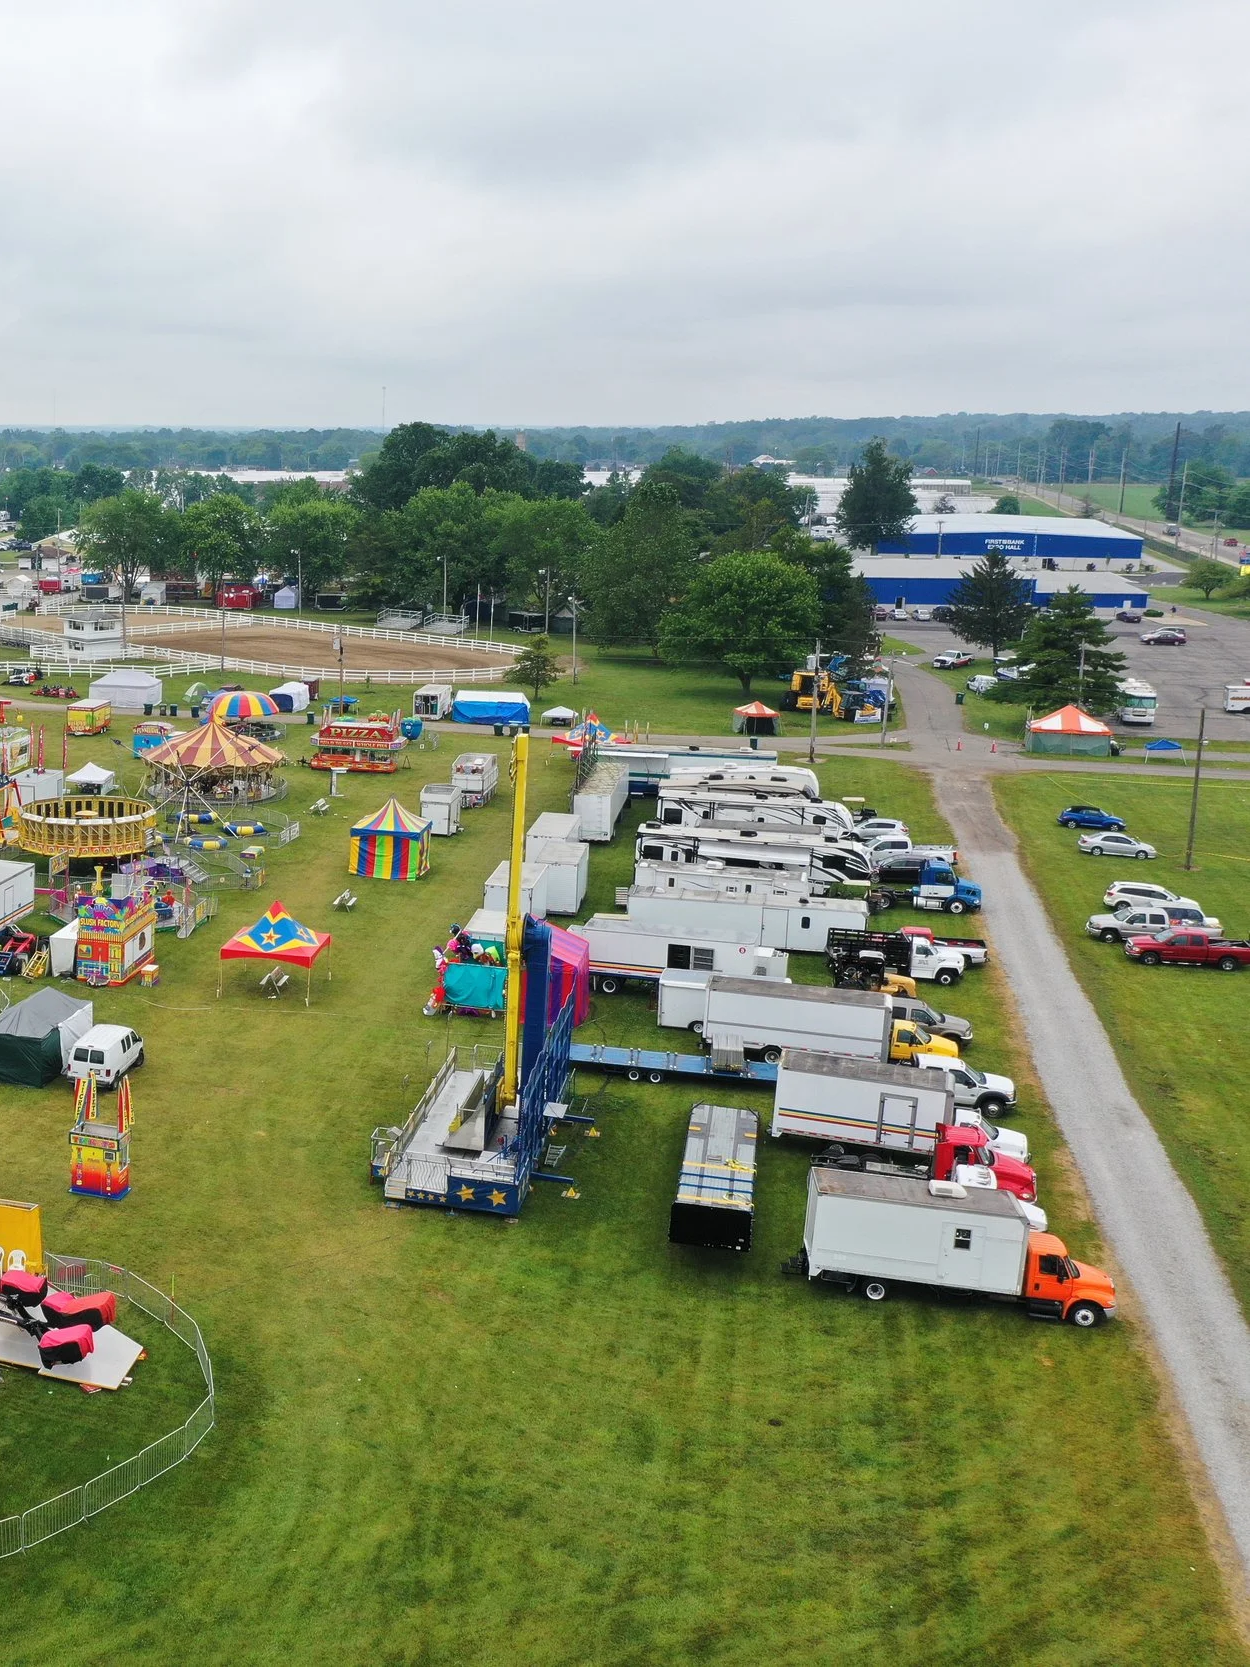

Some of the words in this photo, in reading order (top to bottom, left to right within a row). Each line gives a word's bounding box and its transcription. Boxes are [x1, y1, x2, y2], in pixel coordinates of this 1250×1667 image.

[330, 728, 382, 738] PIZZA
[80, 918, 96, 926] SLUSH
[97, 918, 120, 928] FACTORY
[72, 1136, 116, 1149] TICKETS
